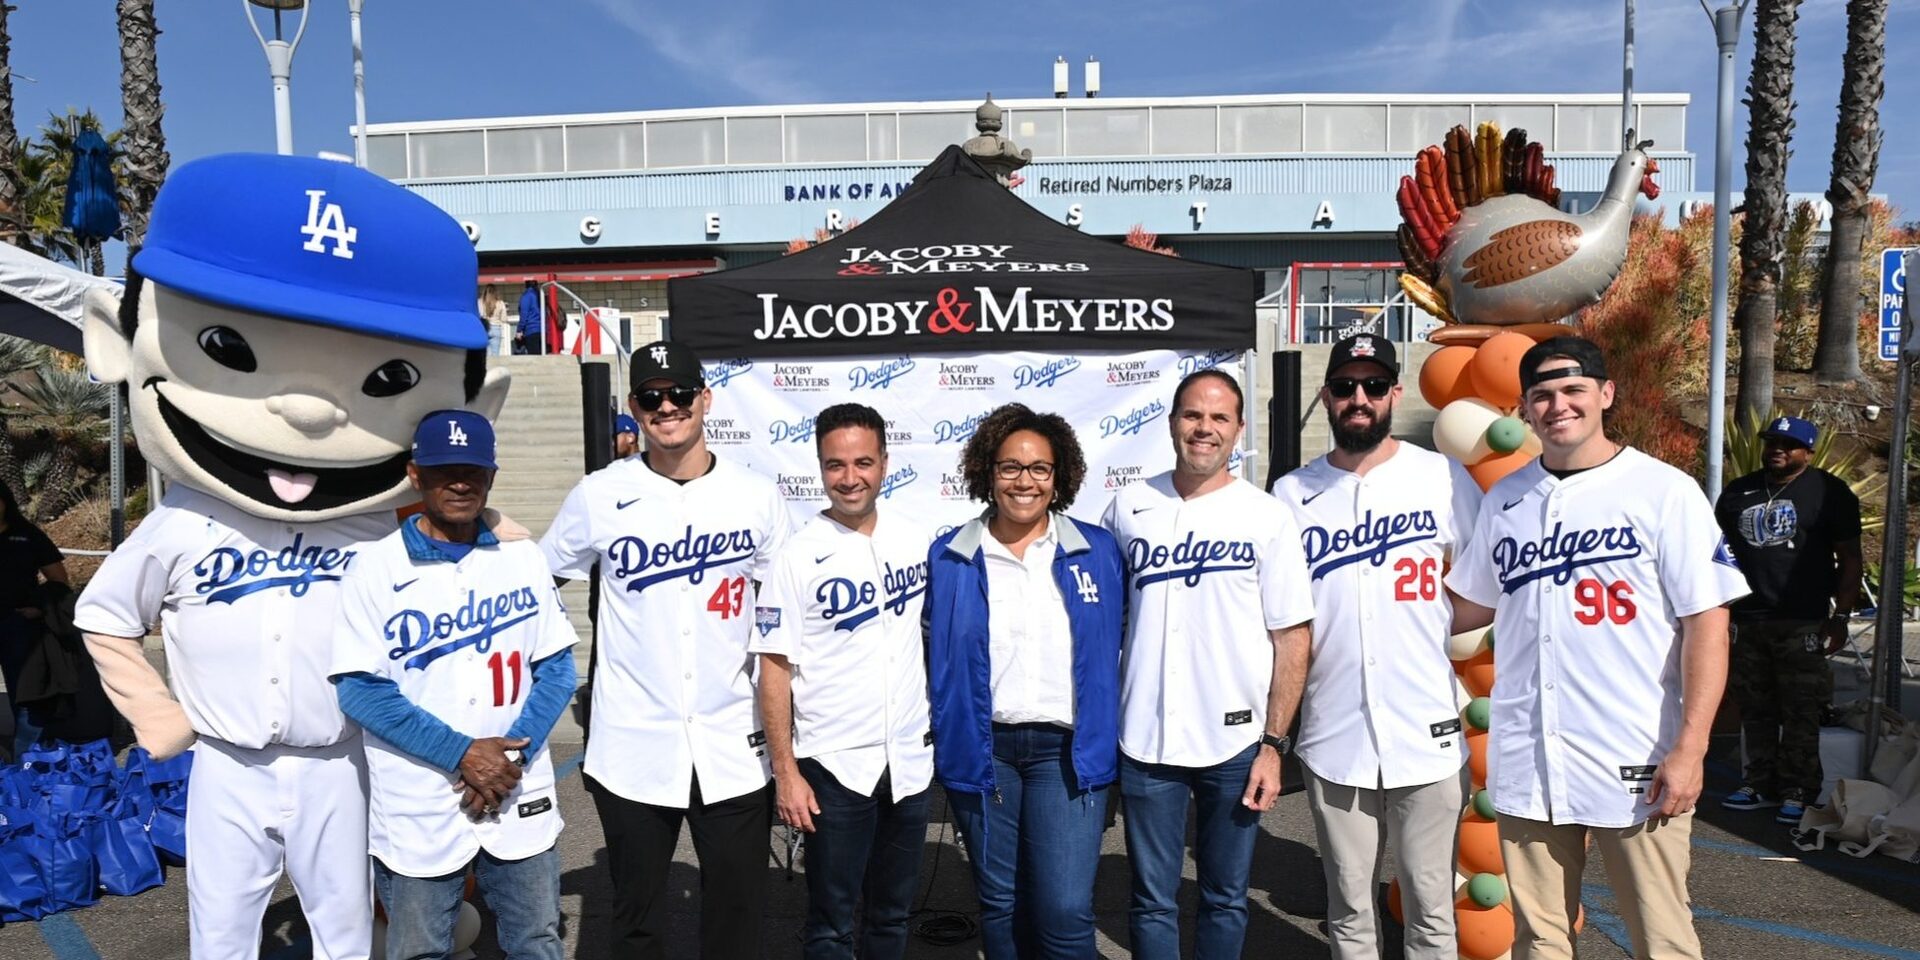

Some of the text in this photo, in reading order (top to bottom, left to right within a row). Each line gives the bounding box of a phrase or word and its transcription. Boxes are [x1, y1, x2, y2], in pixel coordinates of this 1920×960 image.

[784, 183, 841, 201] BANK
[848, 182, 873, 199] OF
[1039, 174, 1233, 195] Retired Numbers Plaza
[301, 190, 357, 259] LA
[839, 244, 1014, 264] JACOBY
[773, 363, 813, 375] JACOBY
[848, 354, 916, 392] Dodgers
[938, 362, 978, 374] JACOBY
[1013, 355, 1082, 390] Dodgers
[1106, 360, 1147, 372] JACOBY
[448, 420, 468, 446] LA
[702, 419, 735, 428] COBY
[769, 415, 818, 445] Dodg
[1099, 398, 1165, 438] Dodgers
[776, 473, 816, 485] JACOBY
[1105, 466, 1143, 477] JACOBY
[608, 525, 756, 593] Dodgers
[1127, 531, 1256, 590] Dodgers
[1301, 509, 1437, 583] Dodgers
[1493, 521, 1642, 595] Dodgers
[195, 533, 357, 605] Dodger
[1069, 564, 1099, 603] LA
[1393, 557, 1437, 602] 26
[706, 576, 746, 620] 43
[1574, 578, 1637, 626] 96
[384, 586, 540, 671] Dodgers
[487, 650, 522, 707] 11
